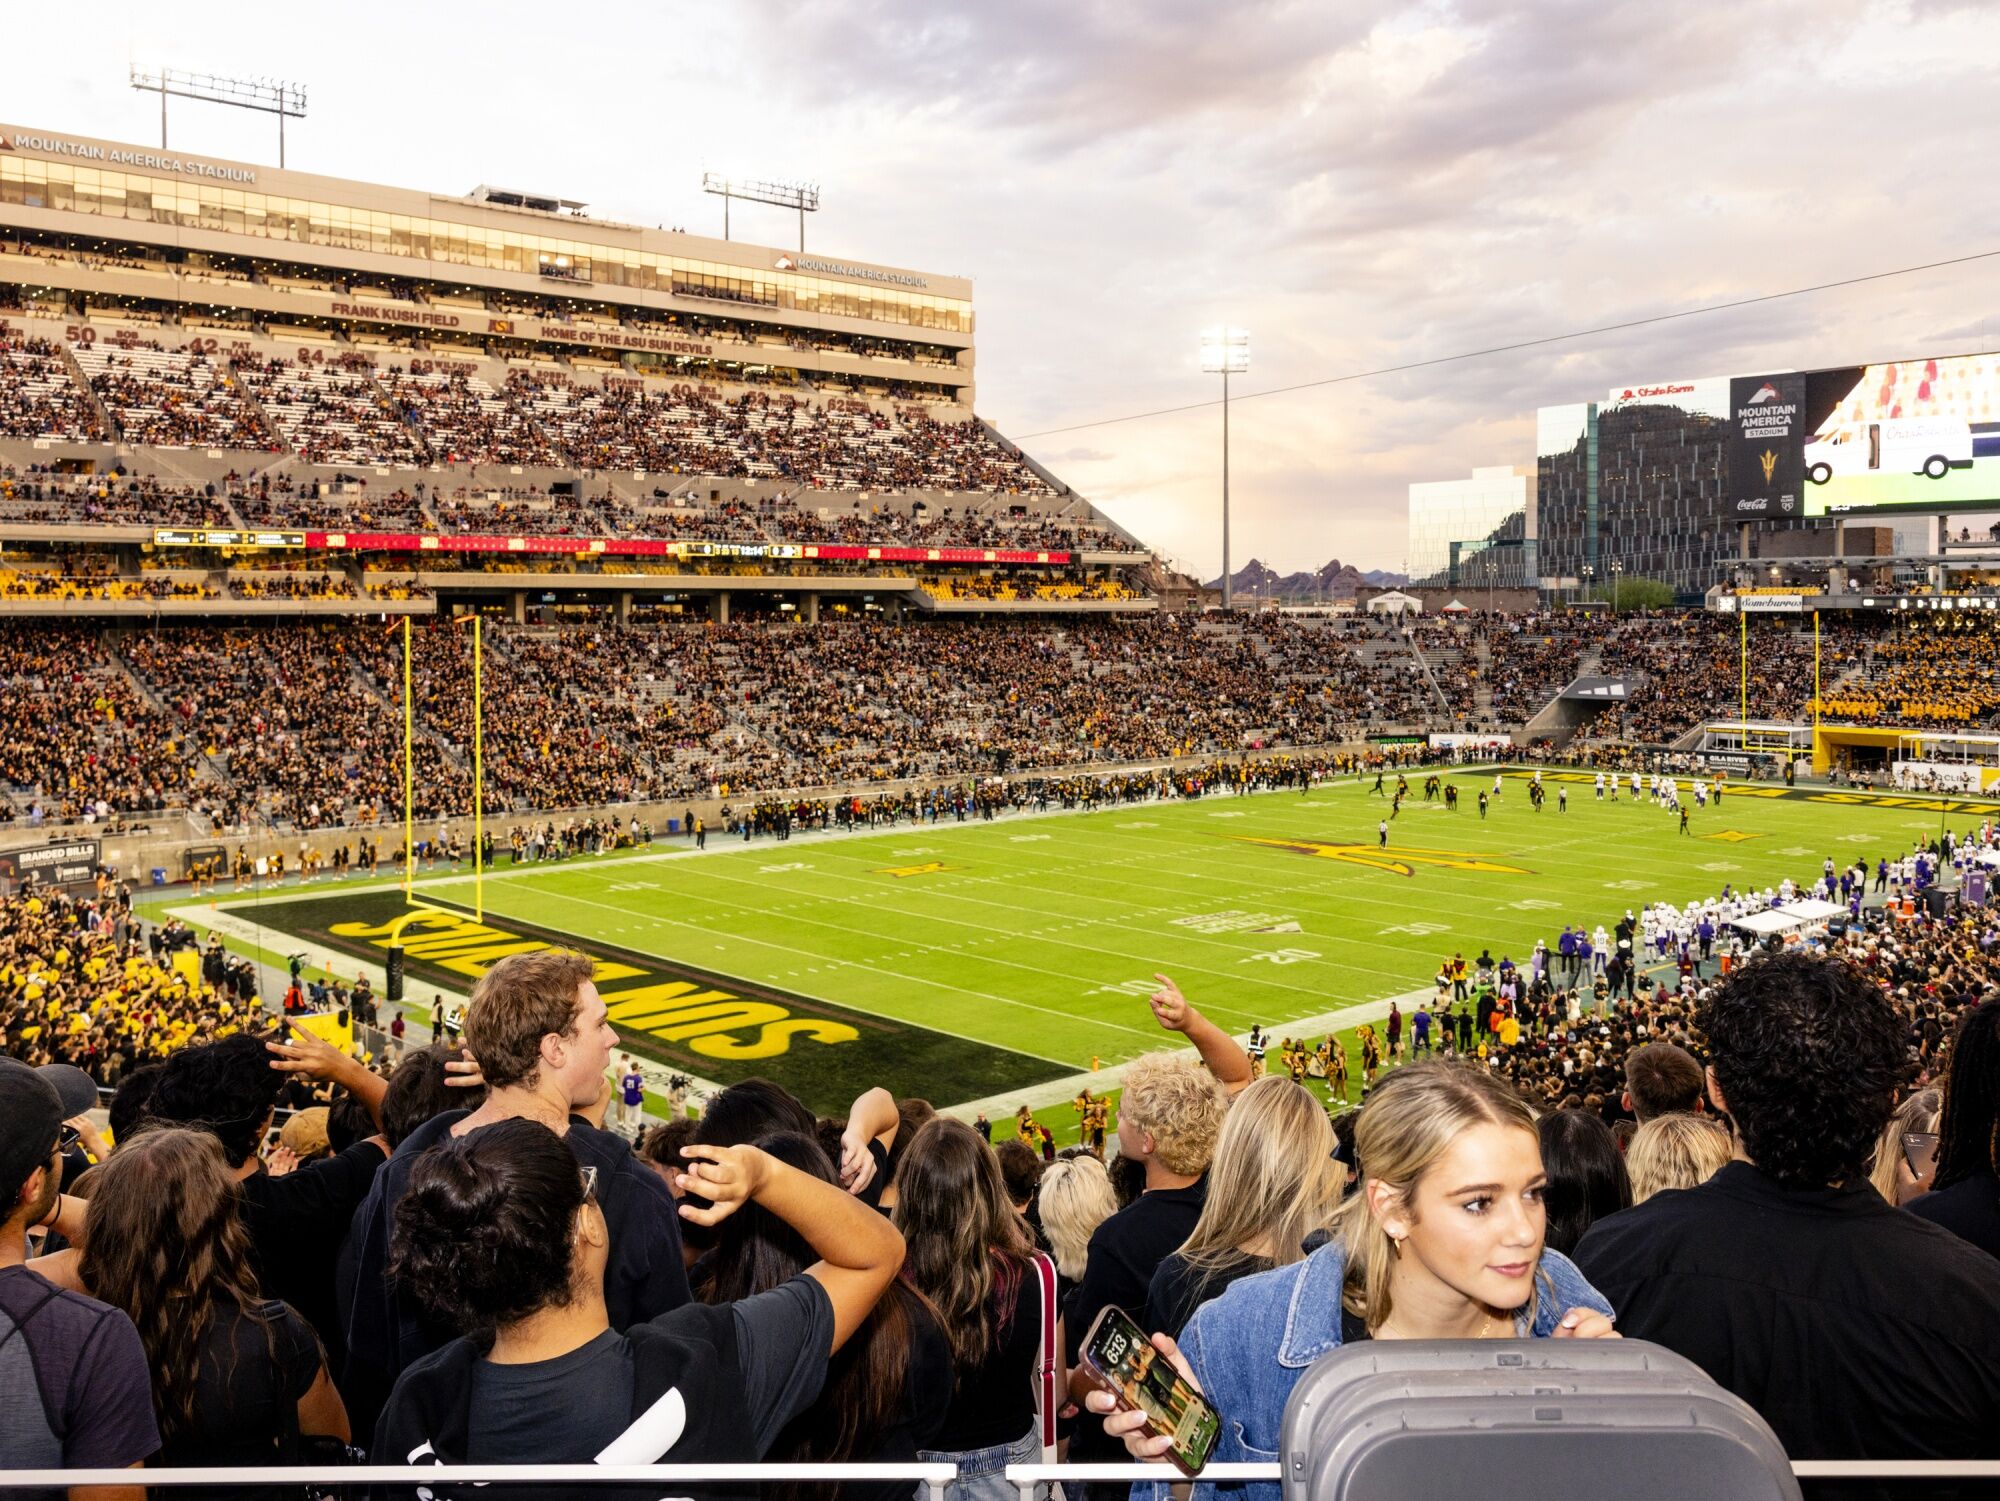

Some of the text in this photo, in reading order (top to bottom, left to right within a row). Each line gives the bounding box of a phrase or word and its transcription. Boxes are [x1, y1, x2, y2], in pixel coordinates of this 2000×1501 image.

[15, 134, 256, 184] MOUNTAIN AMERICA STADIUM
[797, 259, 928, 288] MOUNTAIN AMERICA STADIUM
[331, 303, 460, 327] FRANK KUSH FIELD
[66, 325, 96, 343] 50
[116, 330, 139, 339] BOB
[189, 337, 218, 355] 42
[232, 341, 251, 350] PAT
[542, 327, 712, 355] HOME OF THE ASU SUN DEVILS
[434, 361, 478, 372] WILFORD
[1638, 385, 1694, 397] State Farm
[827, 399, 845, 412] 62
[1738, 404, 1796, 418] MOUNTAIN
[1741, 416, 1792, 428] AMERICA
[1750, 428, 1784, 437] STADIUM
[326, 535, 346, 547] 3RD
[420, 536, 439, 548] 3RD
[741, 545, 763, 555] 12:14
[1727, 755, 1749, 763] RIVER
[19, 848, 65, 863] BRANDED
[66, 845, 94, 858] BILLS
[1251, 948, 1322, 965] 20
[606, 980, 859, 1060] SUN
[626, 1079, 634, 1089] 21
[1106, 1334, 1127, 1365] 6:13
